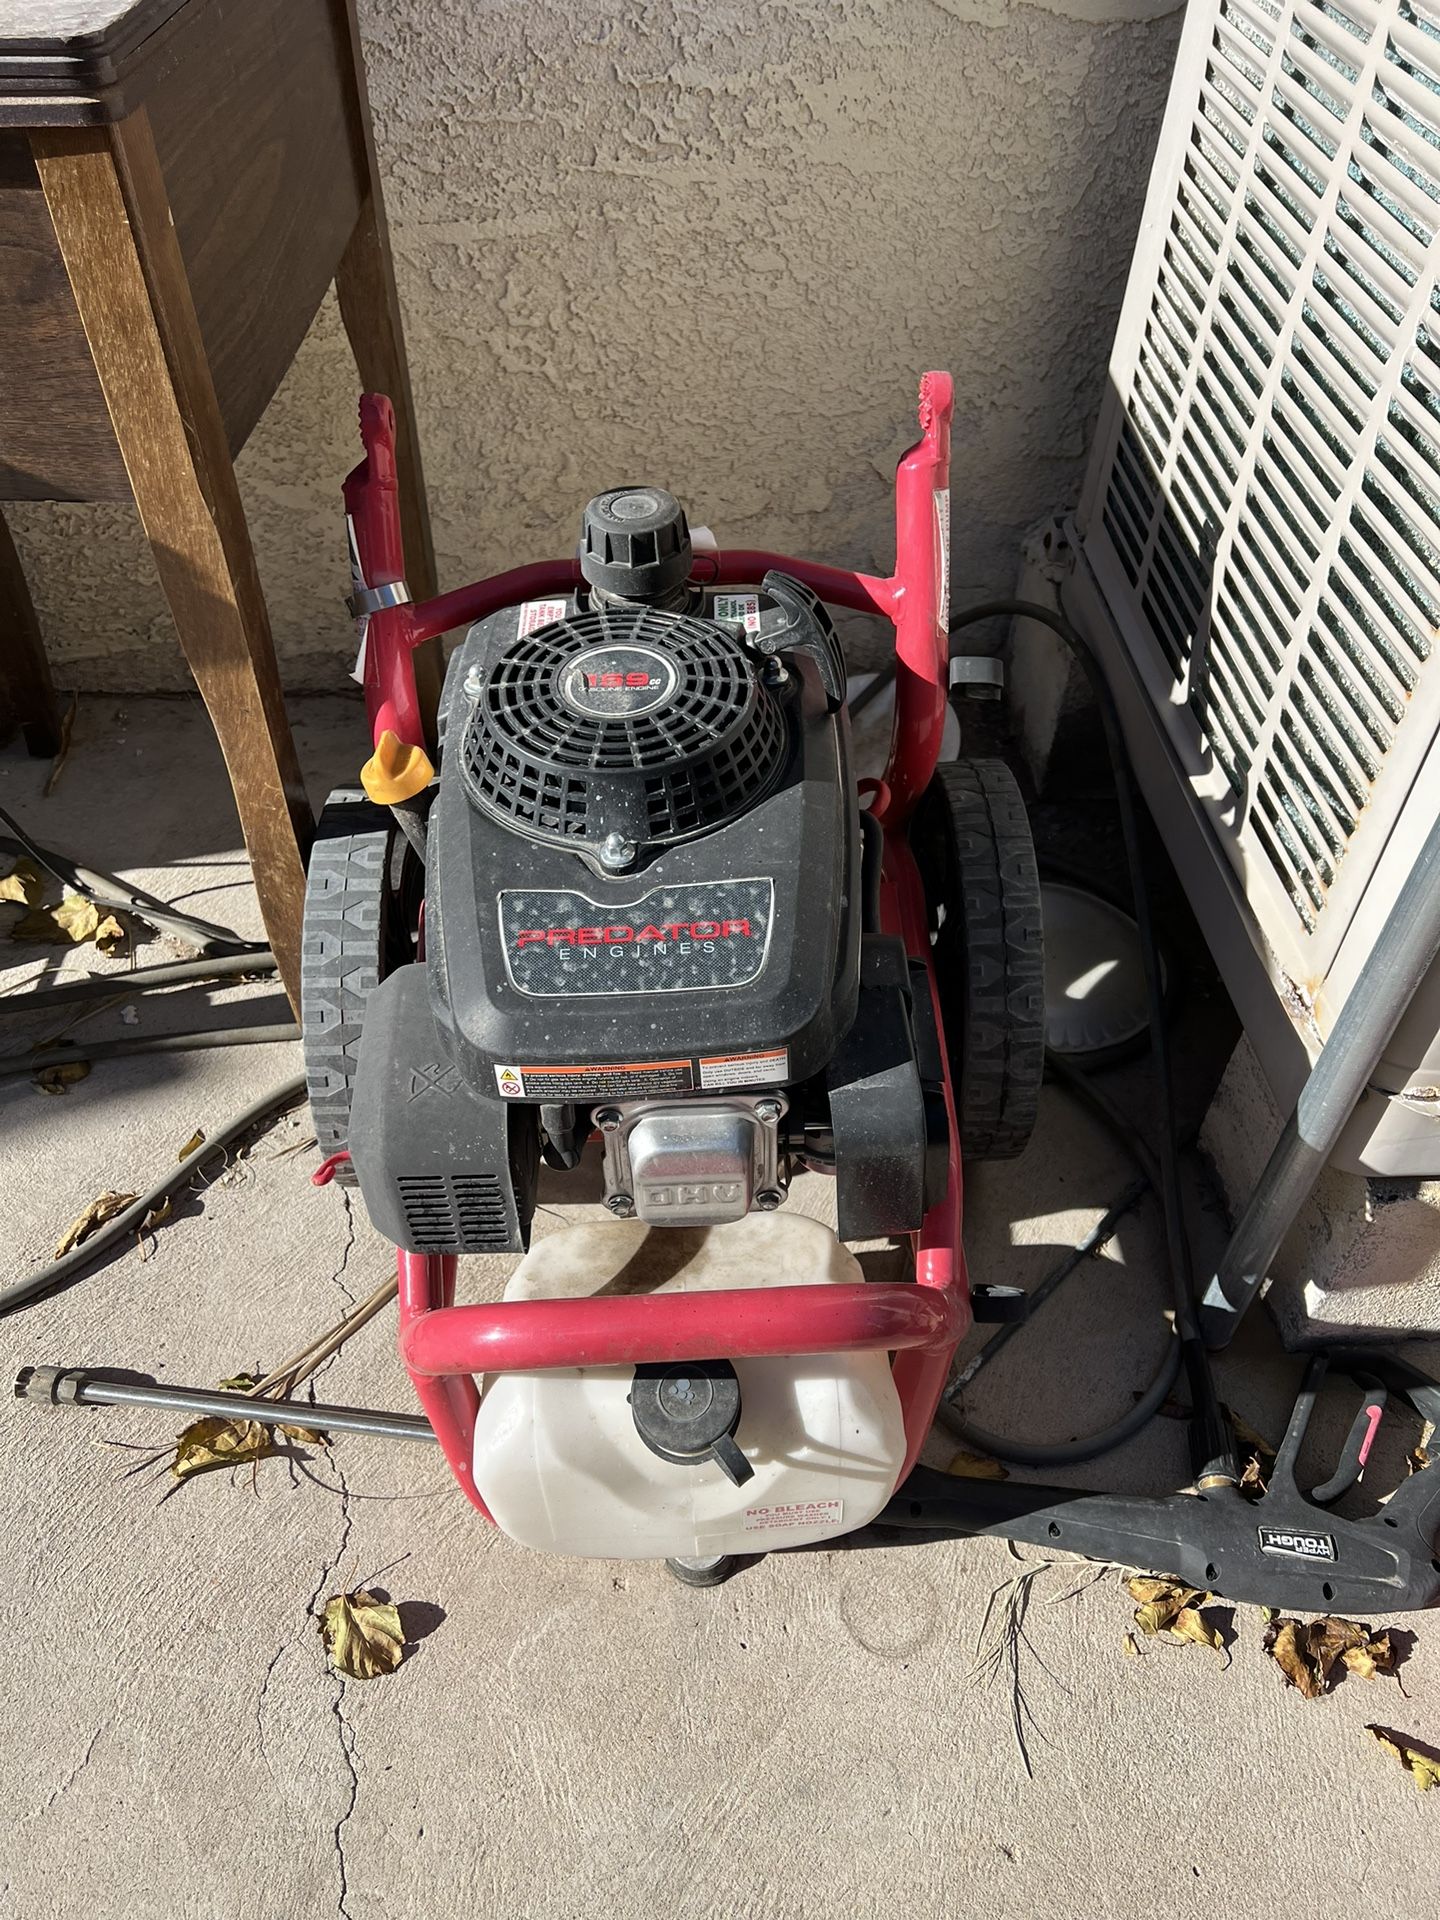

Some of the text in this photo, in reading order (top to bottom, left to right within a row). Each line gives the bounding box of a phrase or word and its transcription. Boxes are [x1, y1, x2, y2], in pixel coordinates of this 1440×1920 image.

[538, 604, 547, 618] TANK
[555, 607, 563, 618] YOU
[717, 597, 728, 617] ONLY
[516, 919, 752, 948] PREDATOR
[559, 941, 716, 960] ENGINES
[728, 1054, 765, 1062] WARNING
[644, 1183, 741, 1206] OHV
[746, 1502, 839, 1516] NO BLEACH
[1268, 1533, 1329, 1549] TOUGH
[1295, 1546, 1331, 1556] HYPER
